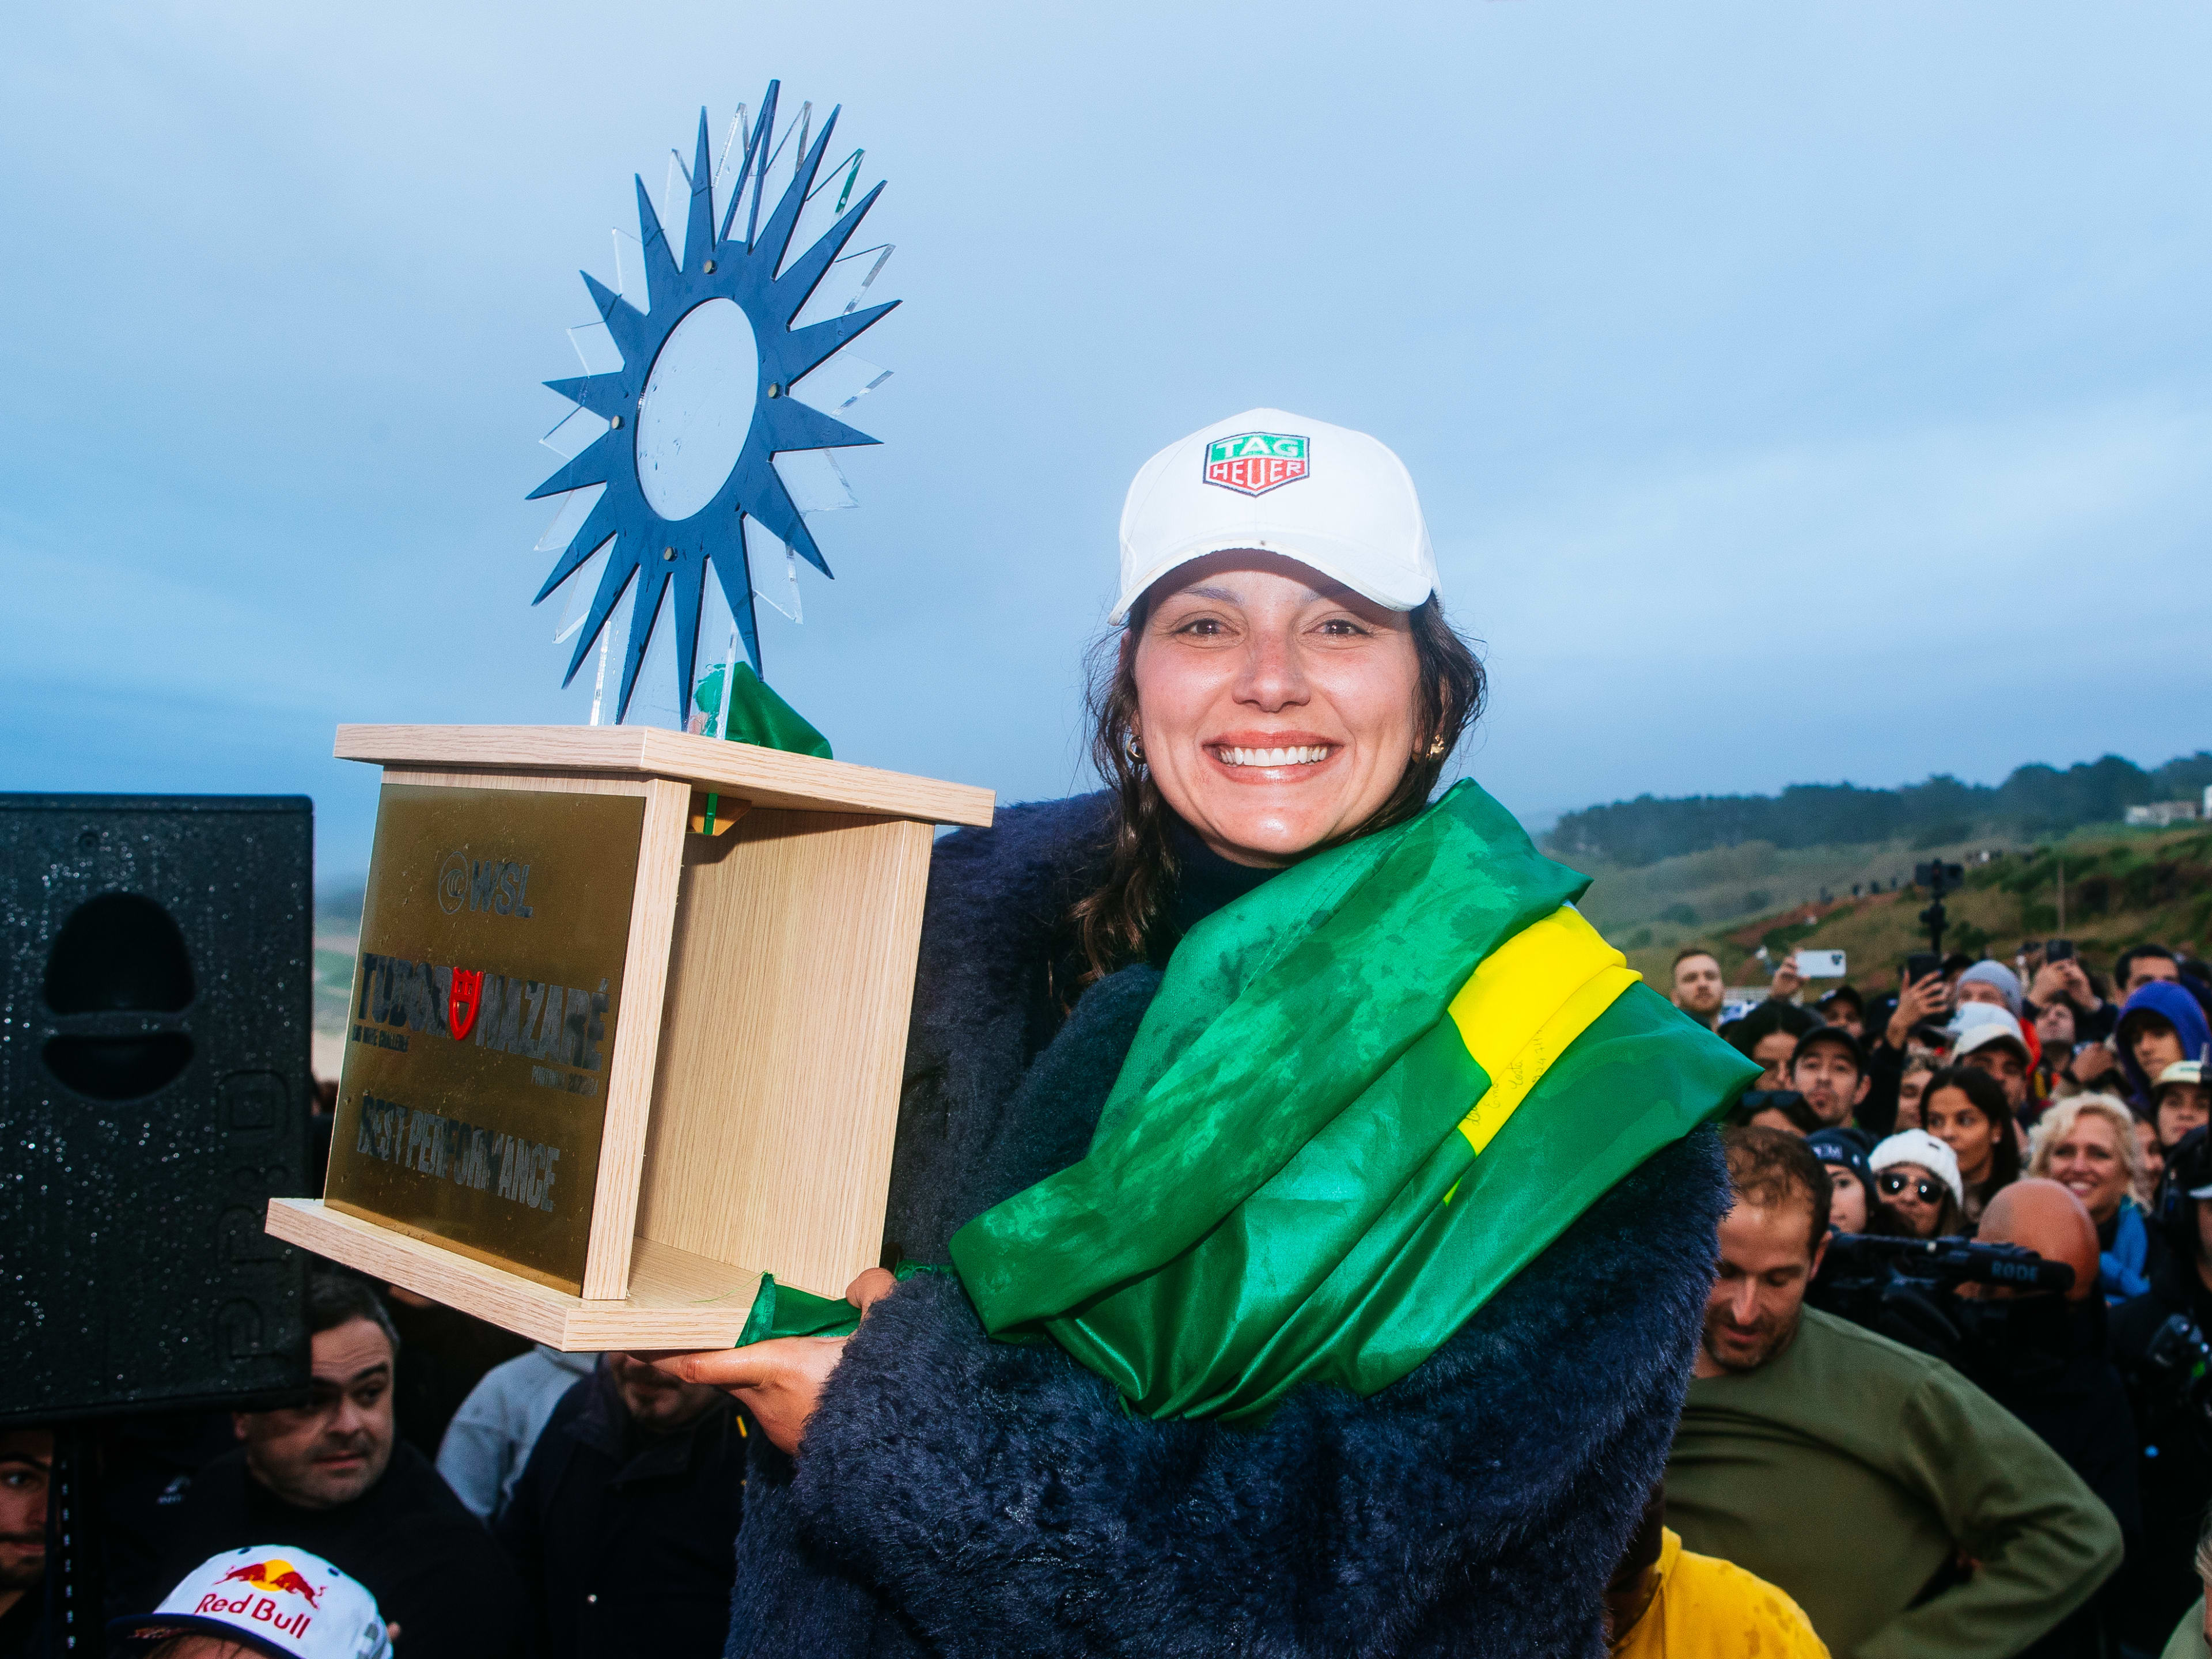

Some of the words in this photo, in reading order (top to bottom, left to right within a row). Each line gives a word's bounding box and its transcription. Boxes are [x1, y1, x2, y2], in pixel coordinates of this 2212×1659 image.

[1215, 436, 1298, 459] TAG
[1212, 459, 1301, 490] HEUER
[469, 859, 534, 918] WSL
[358, 952, 453, 1037] TUDOR
[475, 973, 610, 1071] NAZARÉ
[357, 1096, 408, 1164] BEST
[405, 1109, 560, 1213] PERFORMANCE
[195, 1593, 254, 1615] Red
[251, 1597, 312, 1639] Bull
